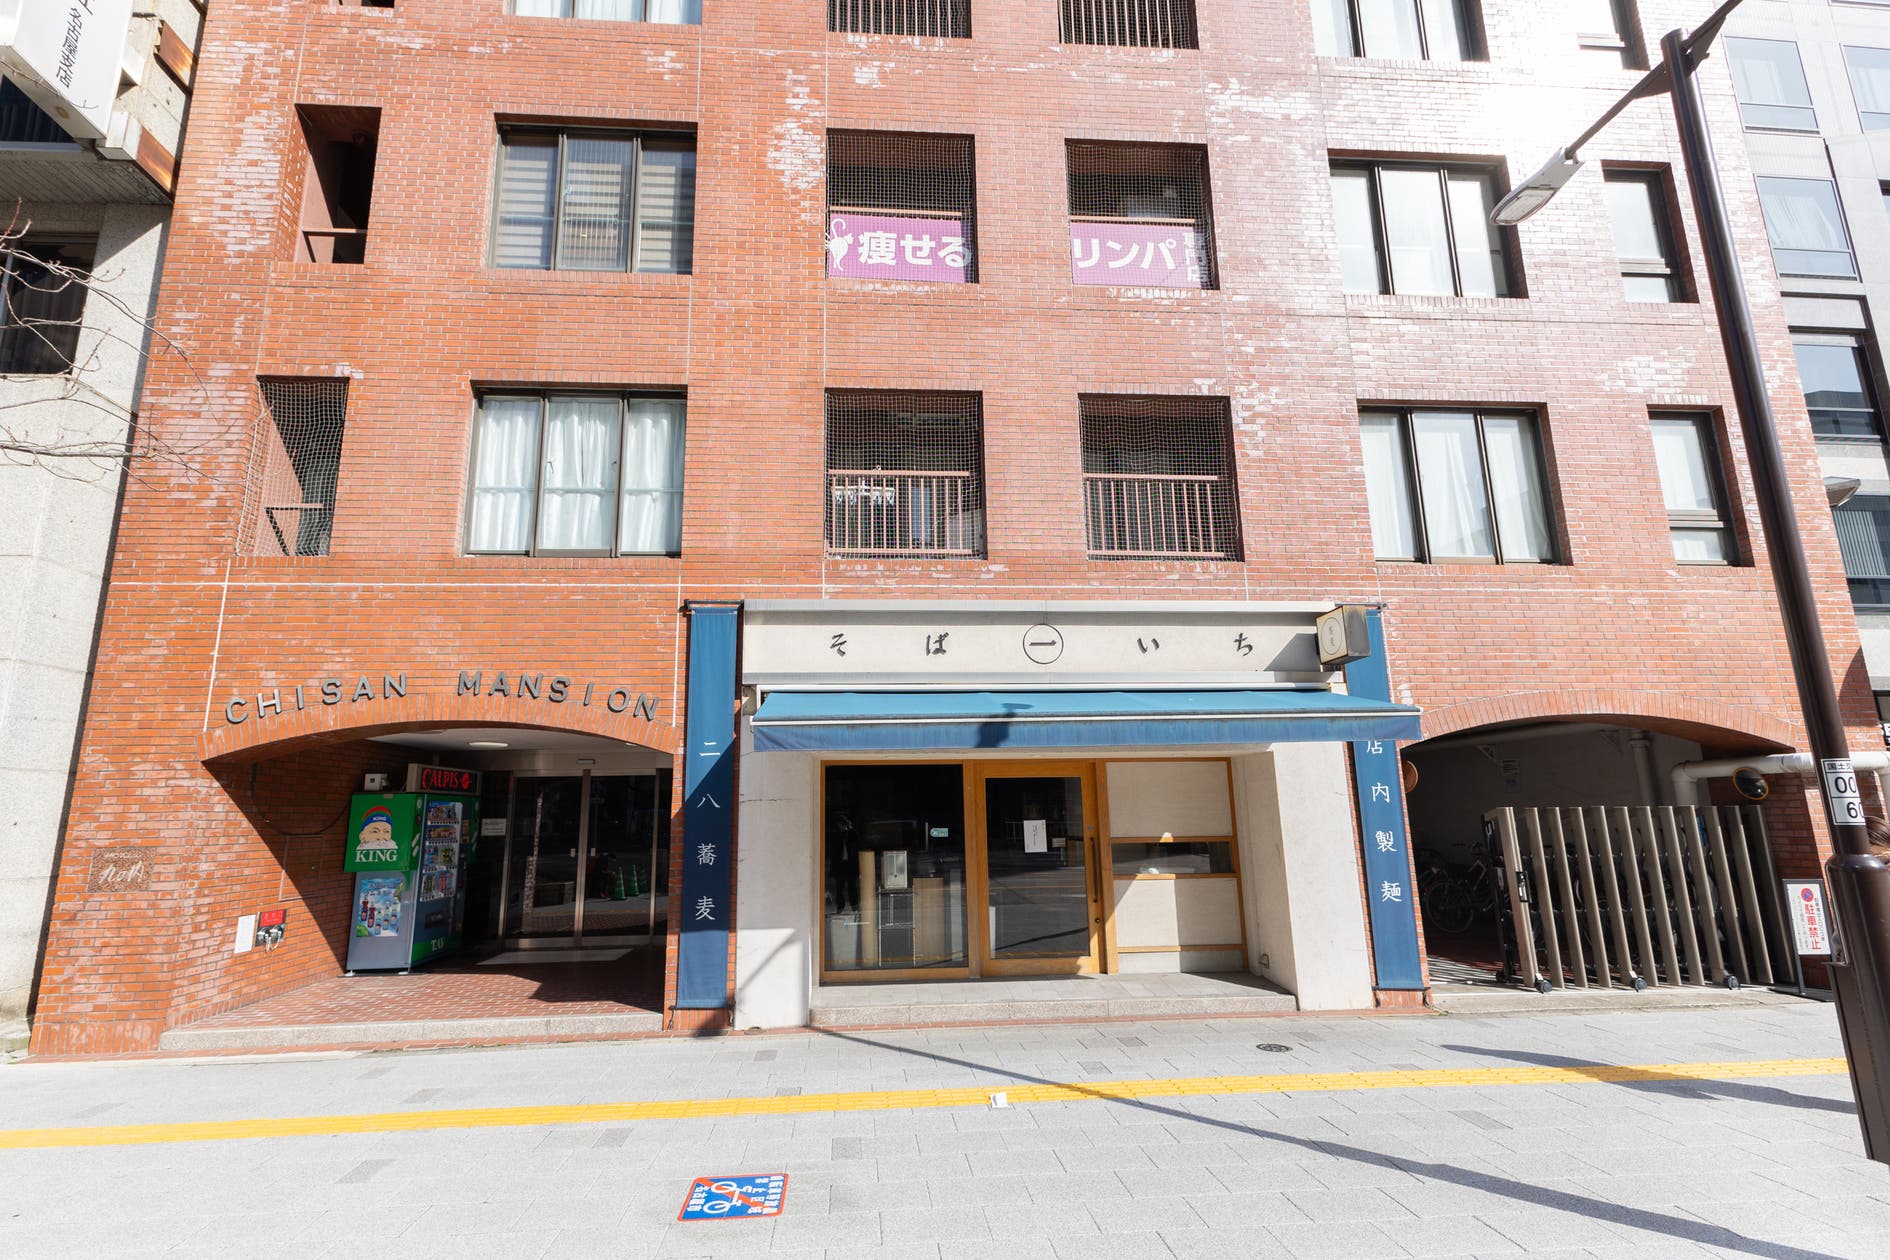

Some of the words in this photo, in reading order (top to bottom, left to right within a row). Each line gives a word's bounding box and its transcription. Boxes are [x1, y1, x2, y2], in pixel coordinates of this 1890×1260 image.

[56, 8, 82, 88] 名古屋支店
[858, 231, 972, 268] 痩せる
[1073, 238, 1177, 270] リンパ
[225, 671, 408, 724] CHISAN
[457, 670, 660, 721] MANSION
[421, 768, 460, 791] CALPIS
[695, 741, 721, 921] 二八蕎麦
[354, 849, 398, 863] KING
[1804, 903, 1821, 950] 駐車禁止
